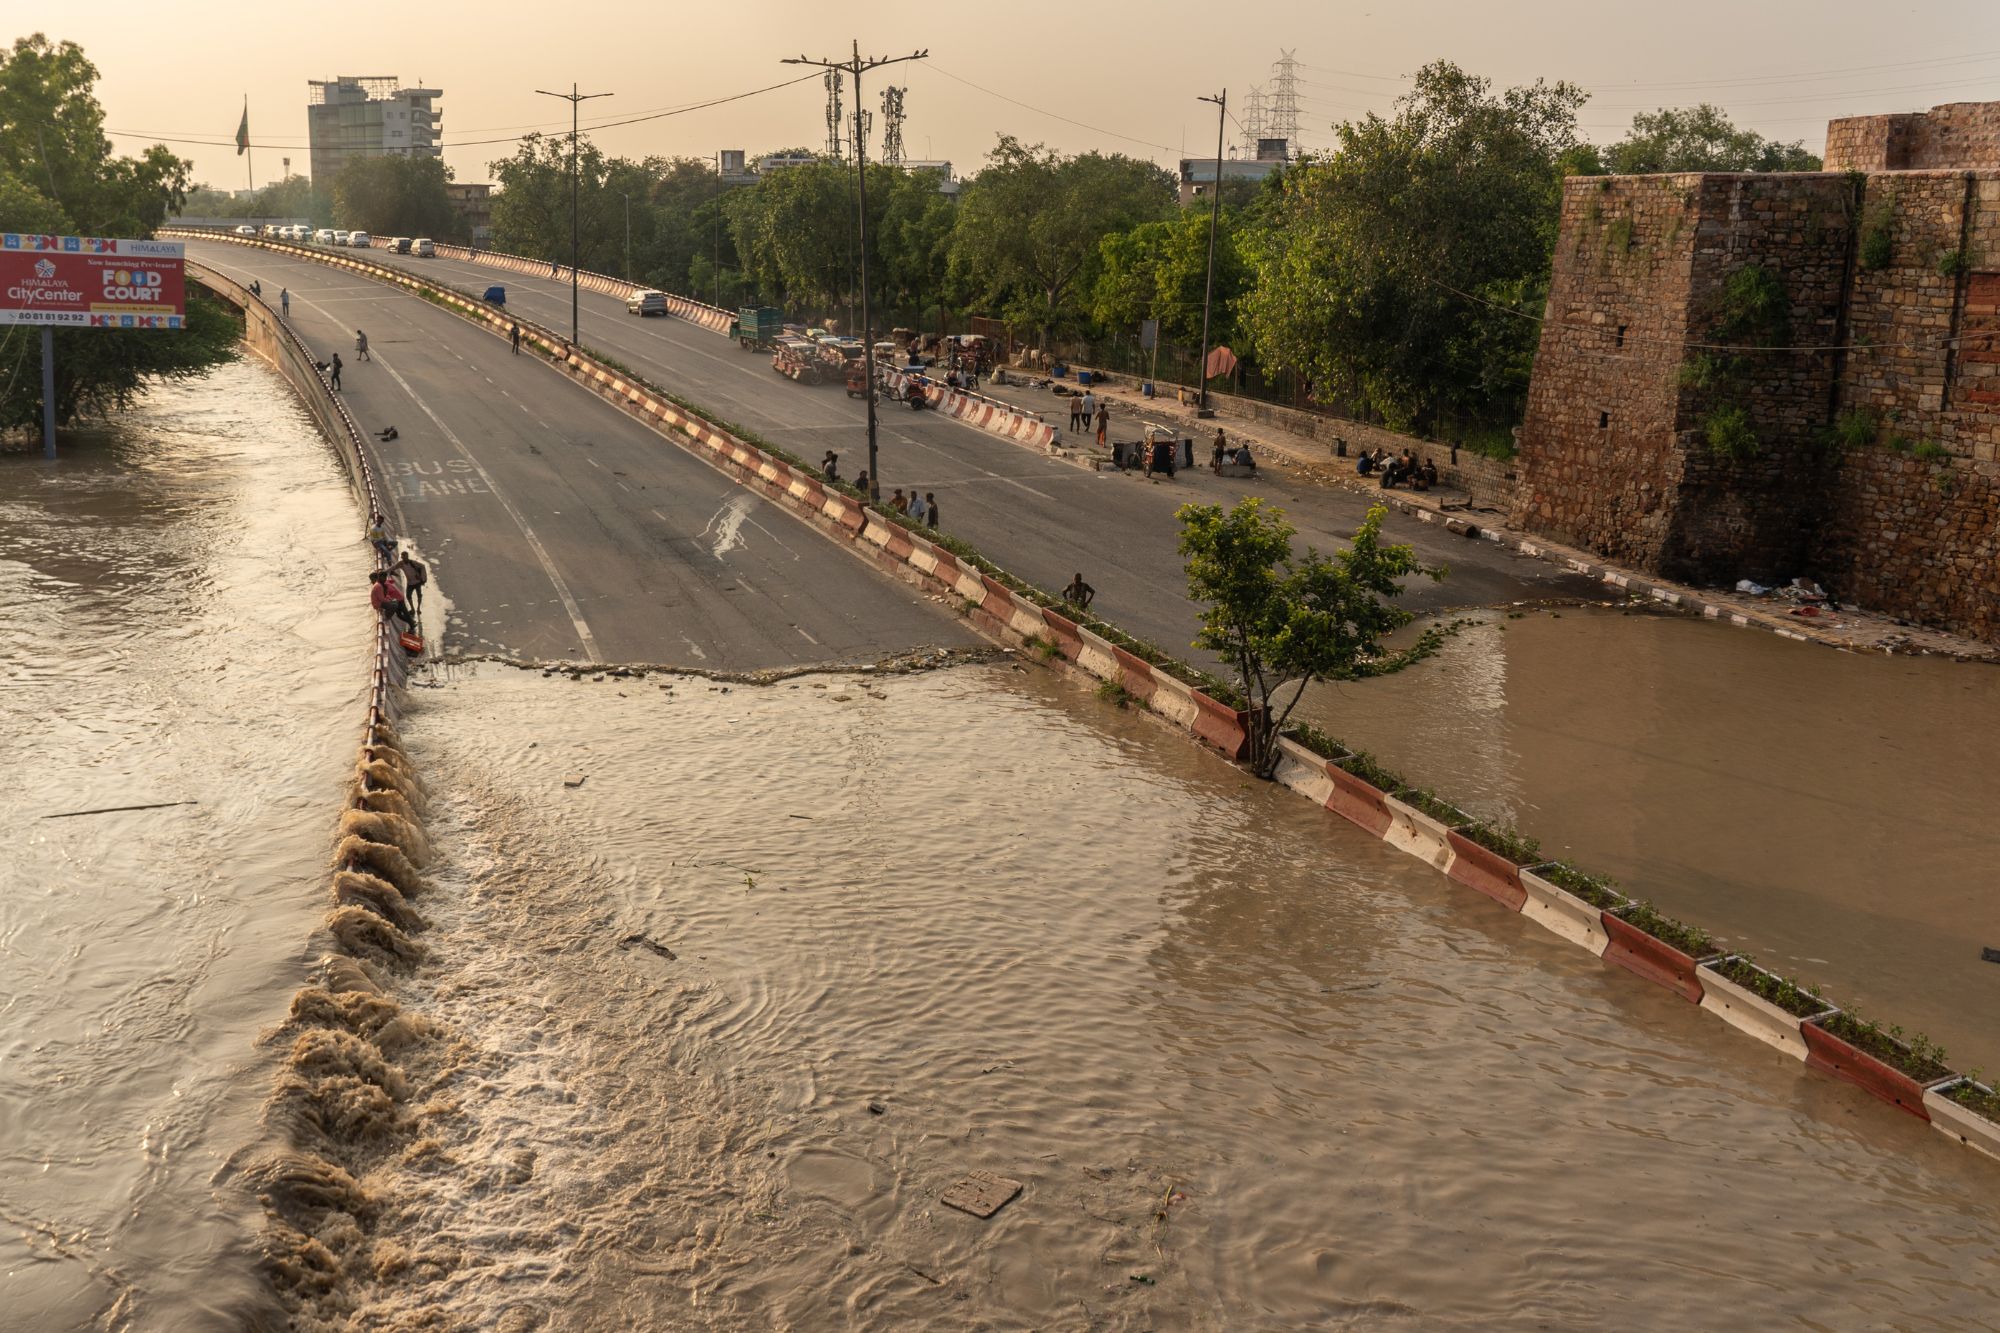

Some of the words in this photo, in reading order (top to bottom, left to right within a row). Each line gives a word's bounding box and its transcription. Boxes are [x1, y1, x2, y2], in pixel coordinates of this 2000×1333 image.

[130, 244, 176, 253] HIMALAYA
[21, 279, 69, 287] HIMALAYA
[102, 269, 162, 286] FOOD
[7, 287, 84, 304] CityCenter
[103, 286, 162, 301] COURT
[385, 460, 473, 476] BUS
[397, 479, 489, 497] LANE
